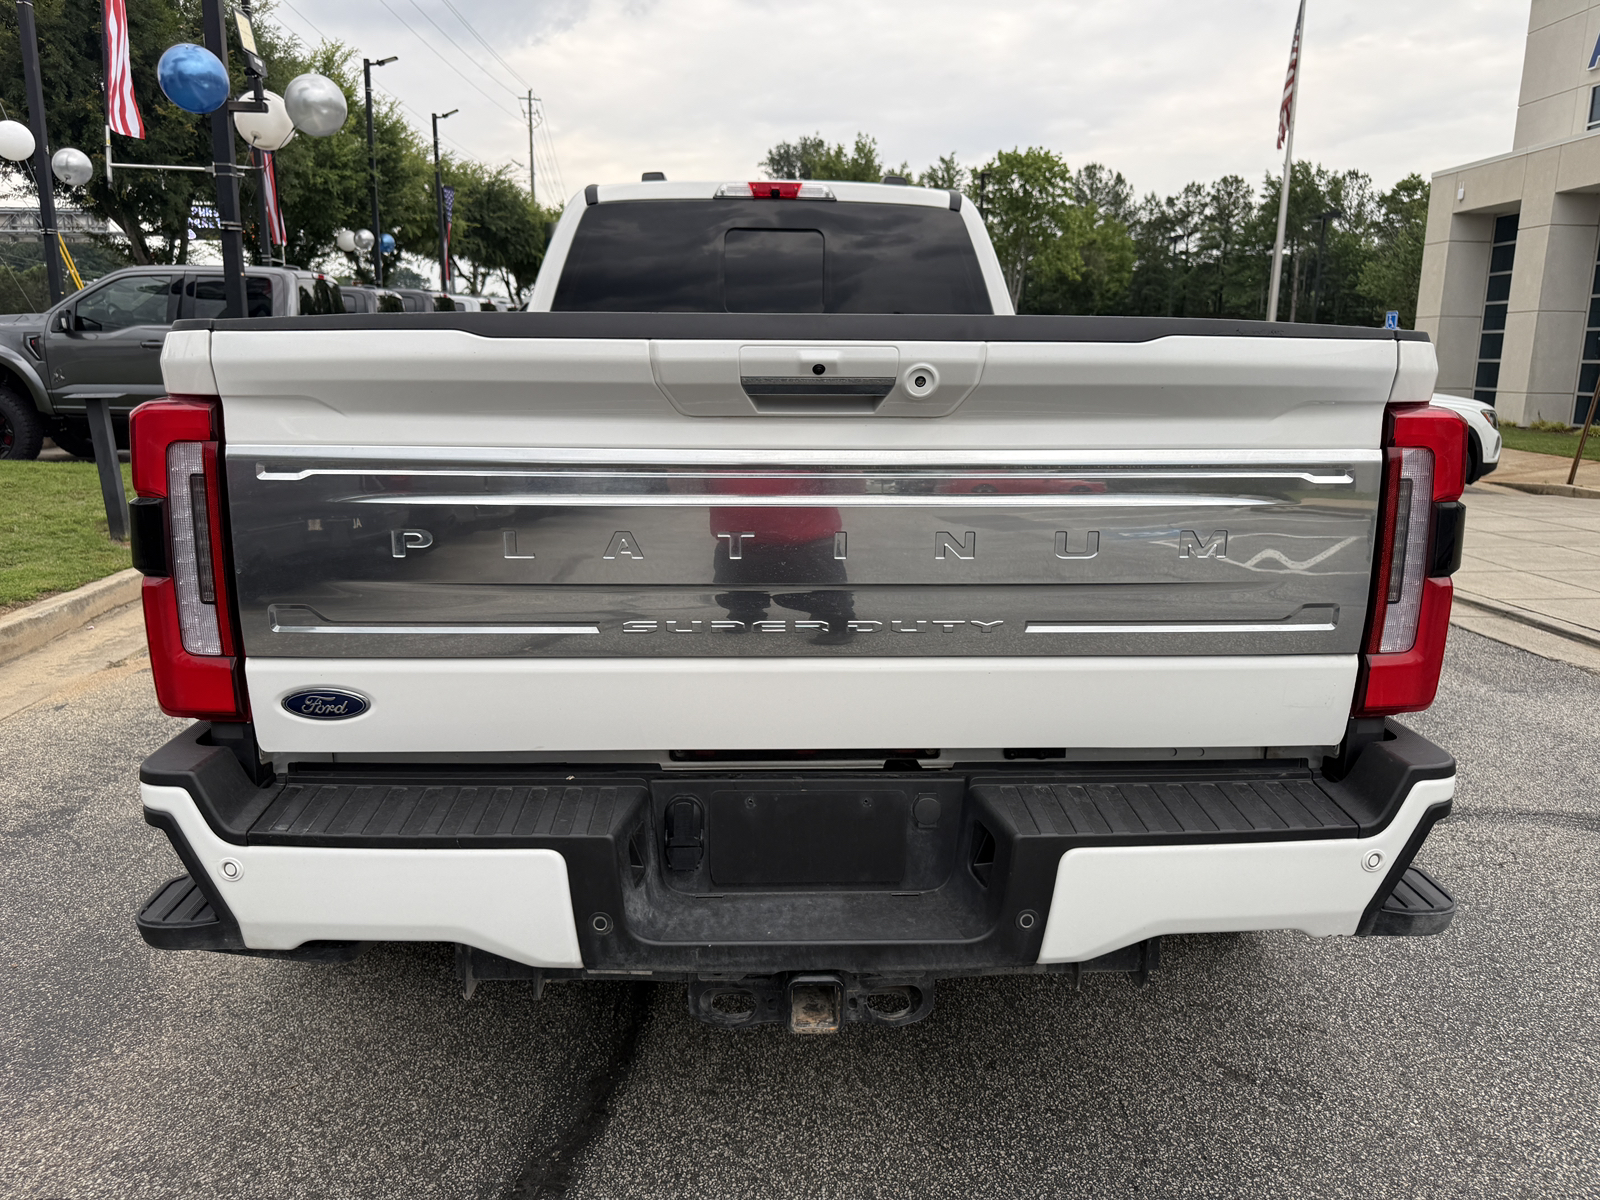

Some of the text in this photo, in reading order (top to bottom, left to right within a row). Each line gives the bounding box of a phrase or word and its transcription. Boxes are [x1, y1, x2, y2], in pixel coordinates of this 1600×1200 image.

[391, 529, 1228, 558] PLATINUM
[622, 620, 1004, 634] SUPER DUTY
[301, 695, 348, 714] Ford
